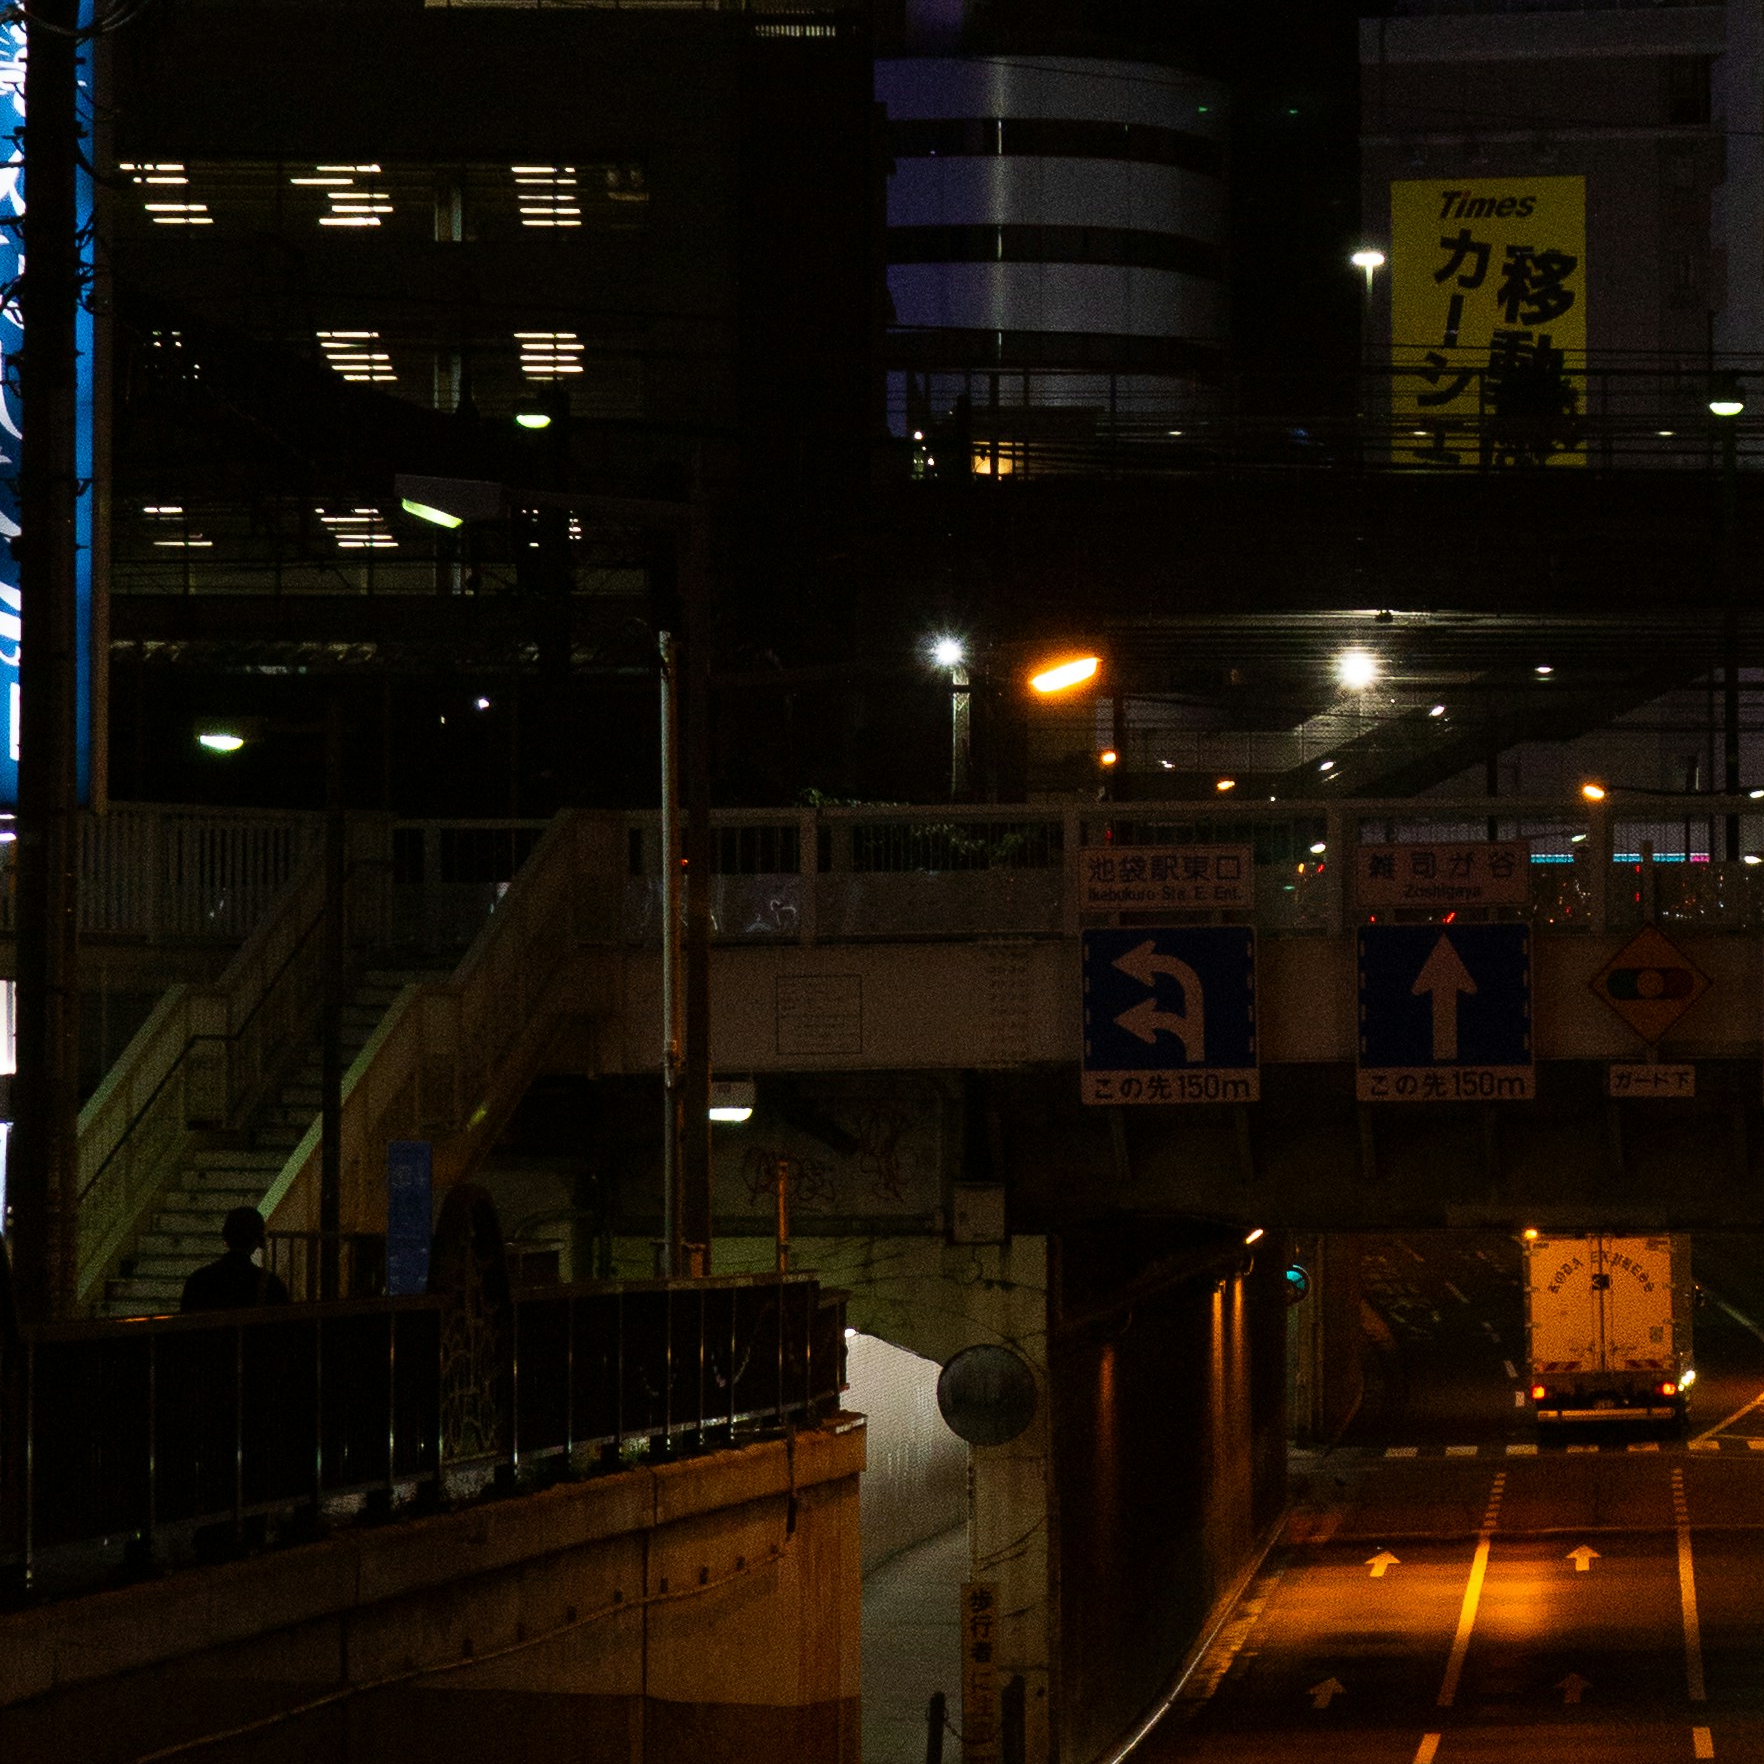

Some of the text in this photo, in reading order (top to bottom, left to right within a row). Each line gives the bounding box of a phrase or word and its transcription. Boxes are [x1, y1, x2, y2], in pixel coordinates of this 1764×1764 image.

[1439, 191, 1537, 220] Times
[1087, 854, 1241, 883] 池袋駅東口
[1369, 851, 1515, 879] 雑司が谷
[1088, 886, 1156, 902] Ikebukuro
[1404, 884, 1482, 899] Zoshigaya
[1095, 1072, 1250, 1100] この先150m
[1370, 1072, 1526, 1098] この先150m
[1615, 1070, 1690, 1089] ガード下
